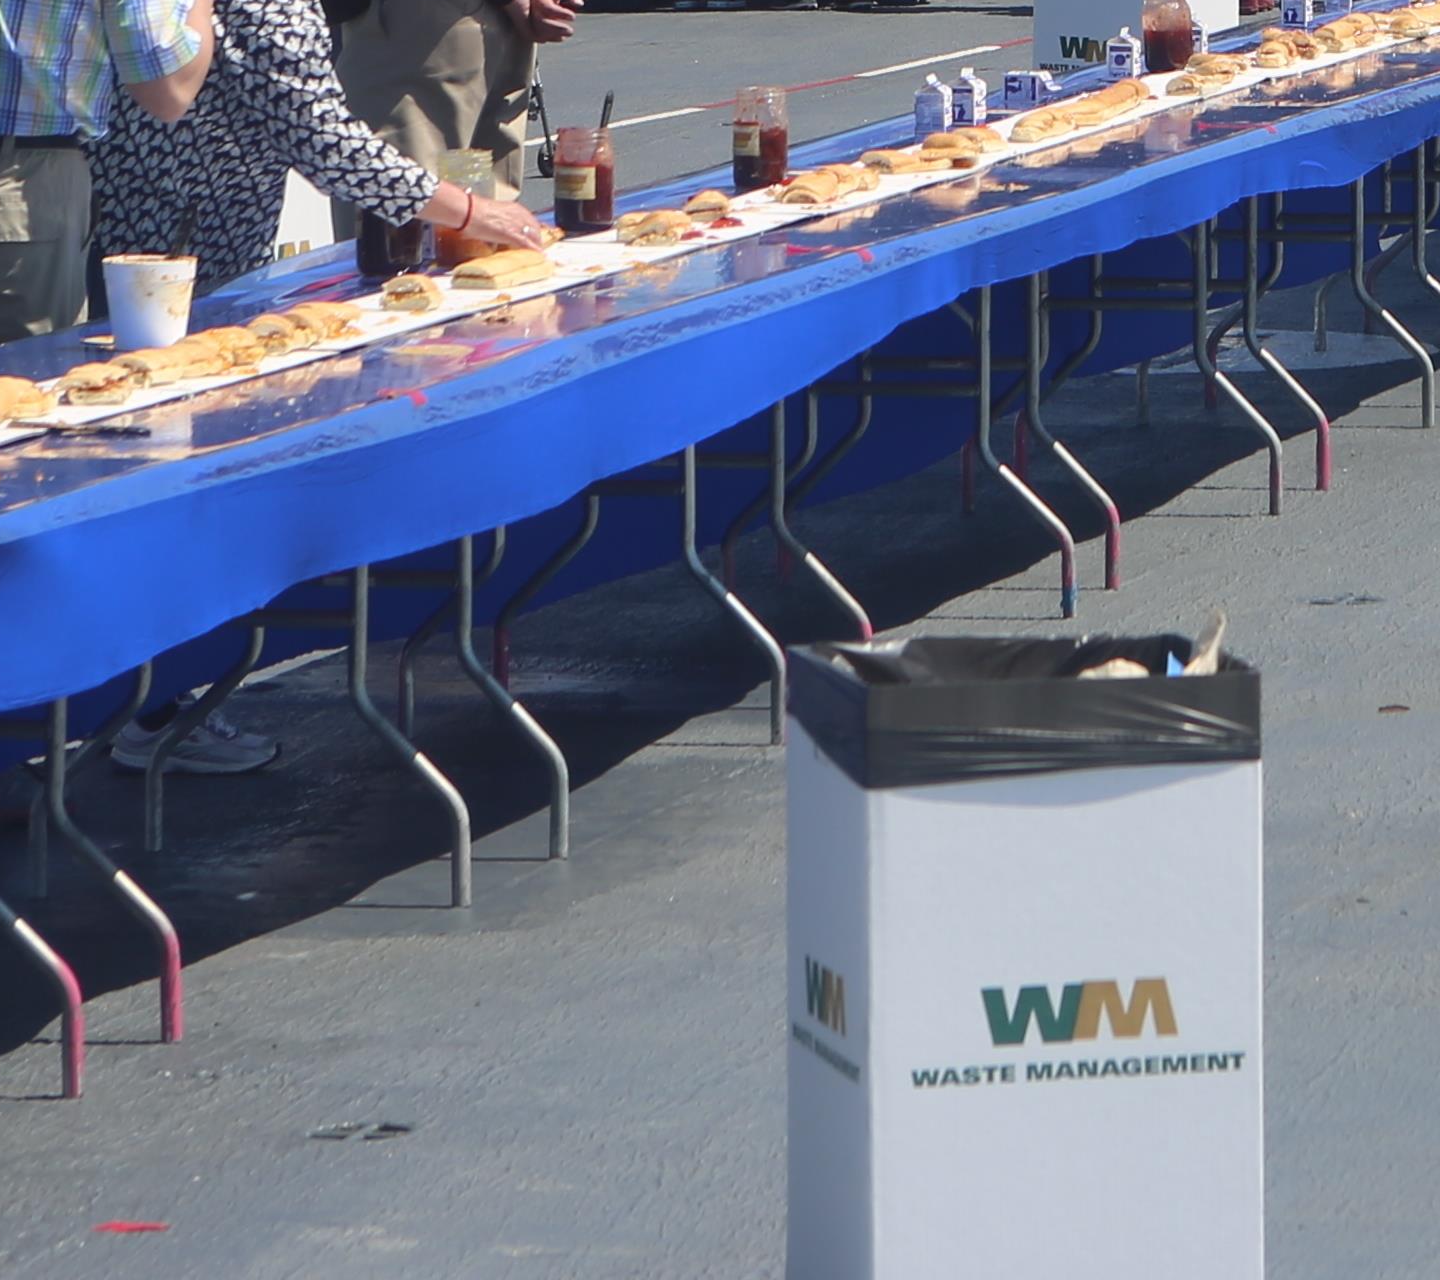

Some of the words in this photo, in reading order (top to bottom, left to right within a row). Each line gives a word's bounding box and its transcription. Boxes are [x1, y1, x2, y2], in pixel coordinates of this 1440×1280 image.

[1039, 63, 1070, 72] WASTE
[804, 955, 847, 1037] WM
[980, 976, 1179, 1047] WM
[911, 1063, 1017, 1088] WASTE
[1025, 1051, 1246, 1083] MANAGEMENT
